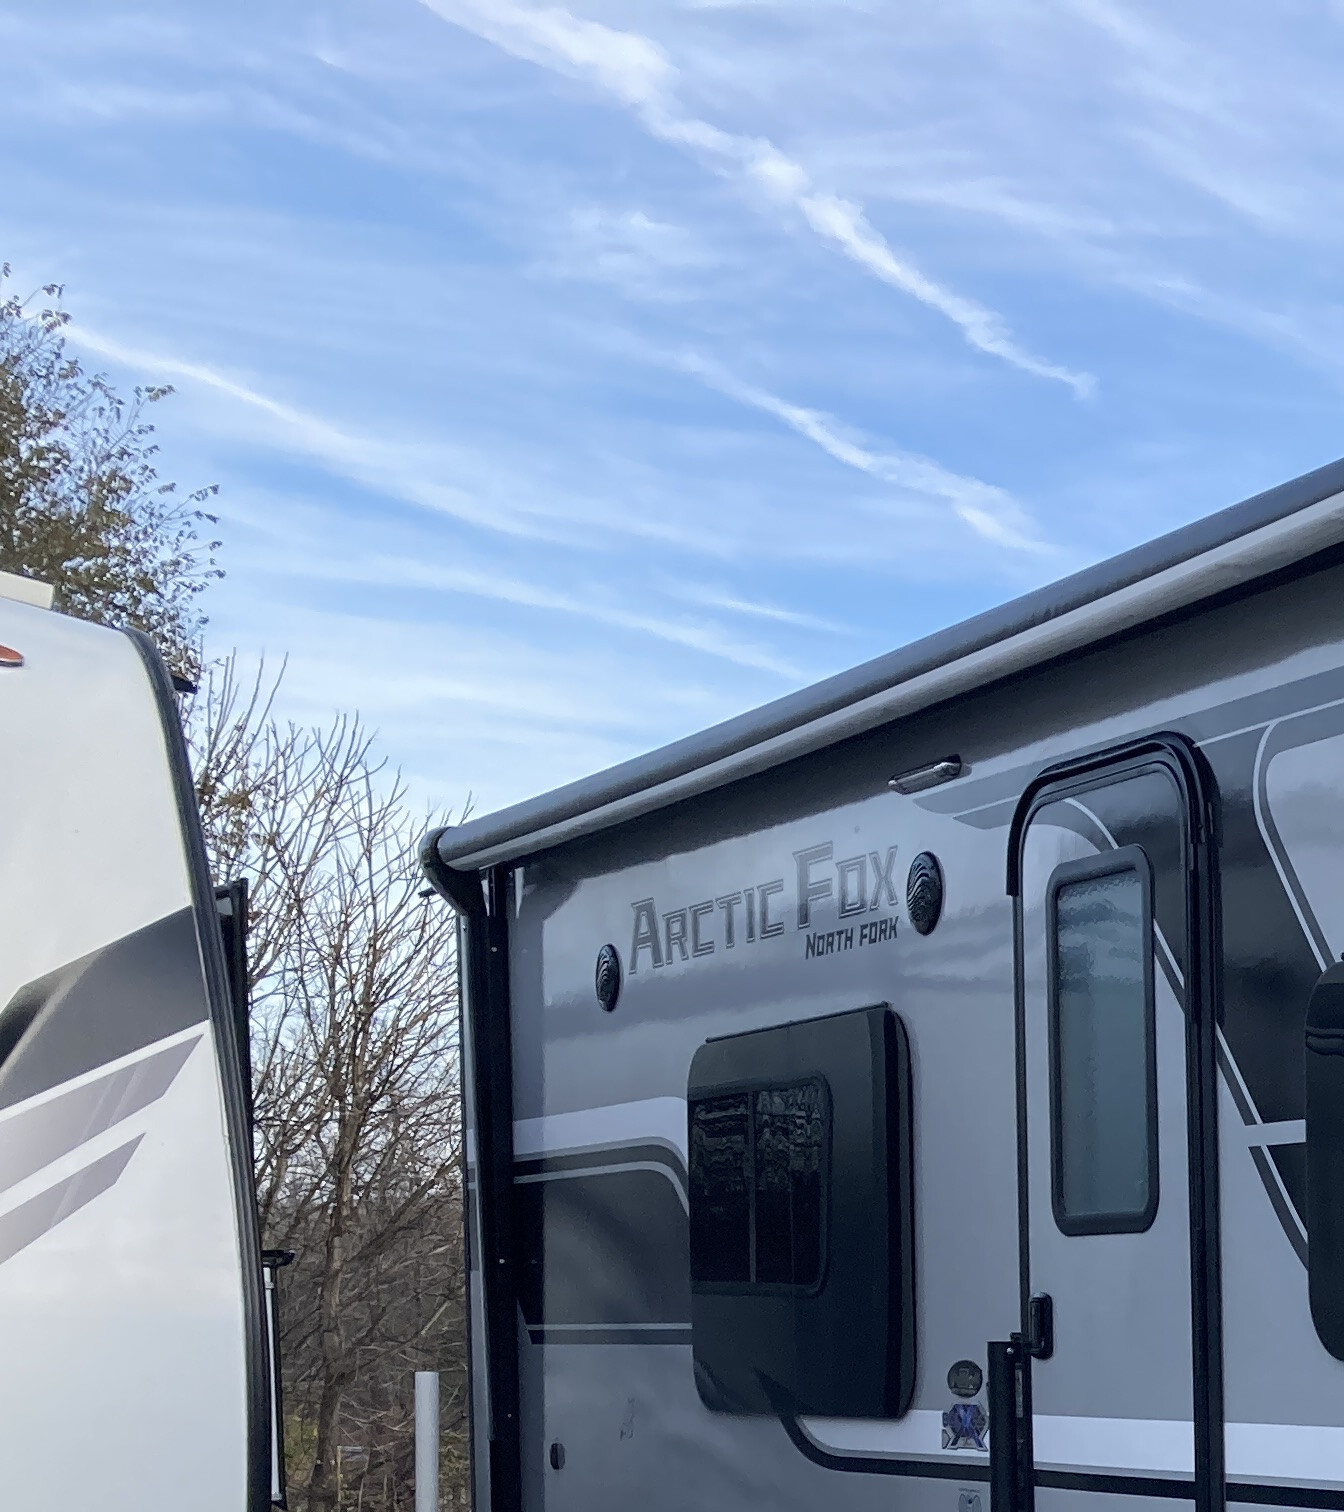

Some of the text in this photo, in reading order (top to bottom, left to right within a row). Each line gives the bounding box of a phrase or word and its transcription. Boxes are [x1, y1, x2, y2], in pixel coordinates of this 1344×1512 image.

[628, 840, 899, 975] ARCTIC FOX
[804, 915, 899, 961] NORTH FORK
